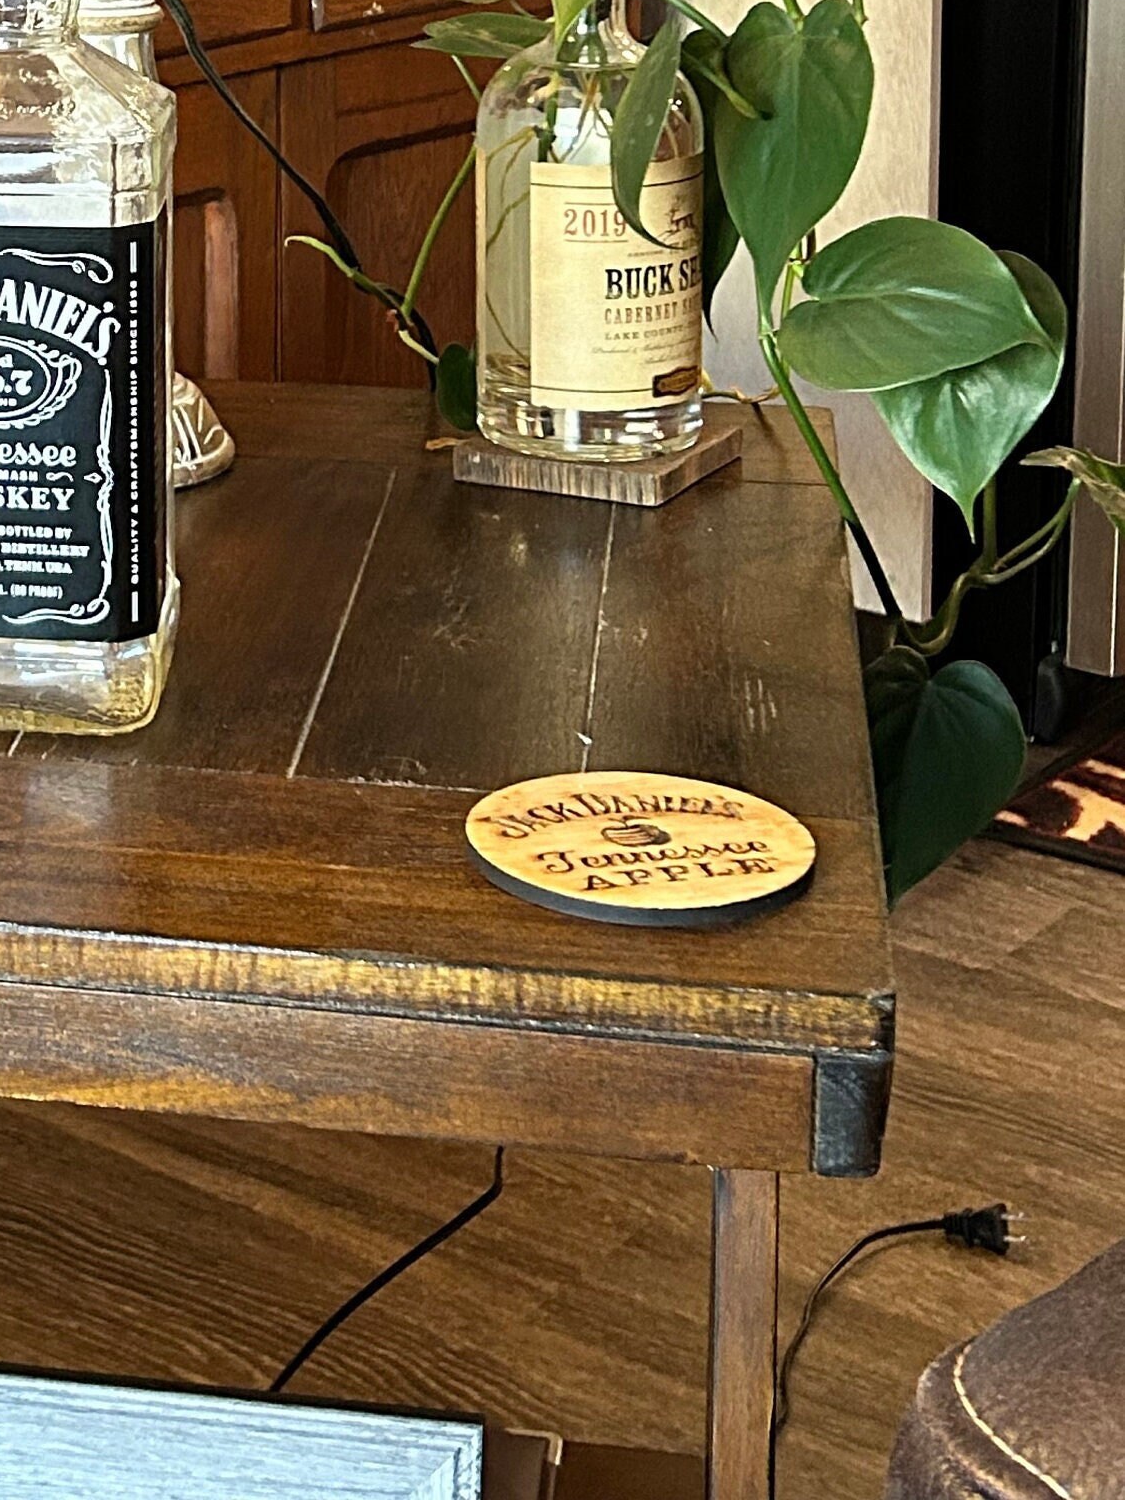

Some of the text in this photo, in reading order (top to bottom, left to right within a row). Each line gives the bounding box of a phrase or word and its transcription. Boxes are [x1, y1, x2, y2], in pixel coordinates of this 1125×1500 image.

[564, 208, 627, 238] 2019
[605, 263, 674, 300] BUCK
[604, 301, 678, 324] CABERNET
[604, 332, 640, 341] LAKE
[0, 542, 91, 558] DISTILLERY
[54, 527, 73, 541] BY
[130, 518, 140, 585] QUALITY
[486, 802, 584, 840] JACK
[538, 839, 771, 874] Tennessee
[581, 857, 779, 892] APPLE
